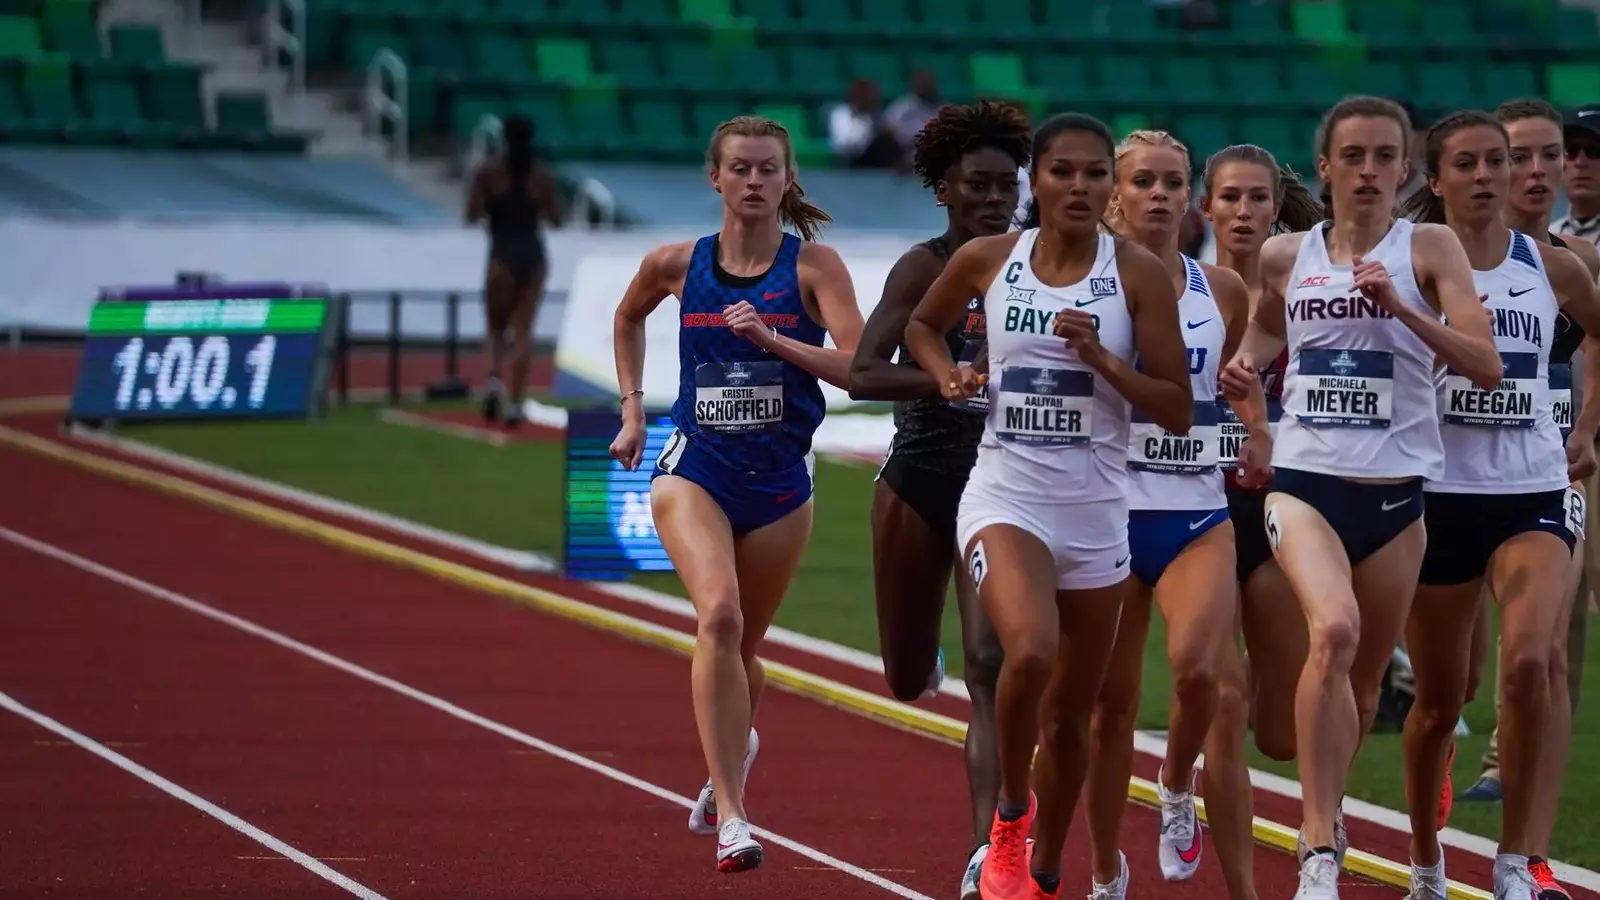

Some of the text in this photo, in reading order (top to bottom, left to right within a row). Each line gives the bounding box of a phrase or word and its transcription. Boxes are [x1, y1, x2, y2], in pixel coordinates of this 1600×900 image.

[1005, 261, 1023, 284] C
[1297, 276, 1331, 289] ACC
[1092, 278, 1115, 292] ONE
[963, 312, 987, 333] FL
[1493, 308, 1543, 349] NOVA
[1187, 347, 1207, 375] U
[113, 335, 277, 411] 1:00.1
[1318, 377, 1367, 390] MICHAELA
[722, 388, 755, 399] KRISTIE
[1024, 396, 1063, 408] AALIYAH
[1307, 389, 1379, 415] MEYER
[1450, 389, 1532, 415] KEEGAN
[696, 398, 782, 421] SCHOFFIELD
[1005, 406, 1082, 433] MILLER
[1552, 401, 1571, 425] CH
[1221, 424, 1250, 435] GEMM
[1144, 436, 1204, 462] CAMP
[971, 550, 983, 587] 6
